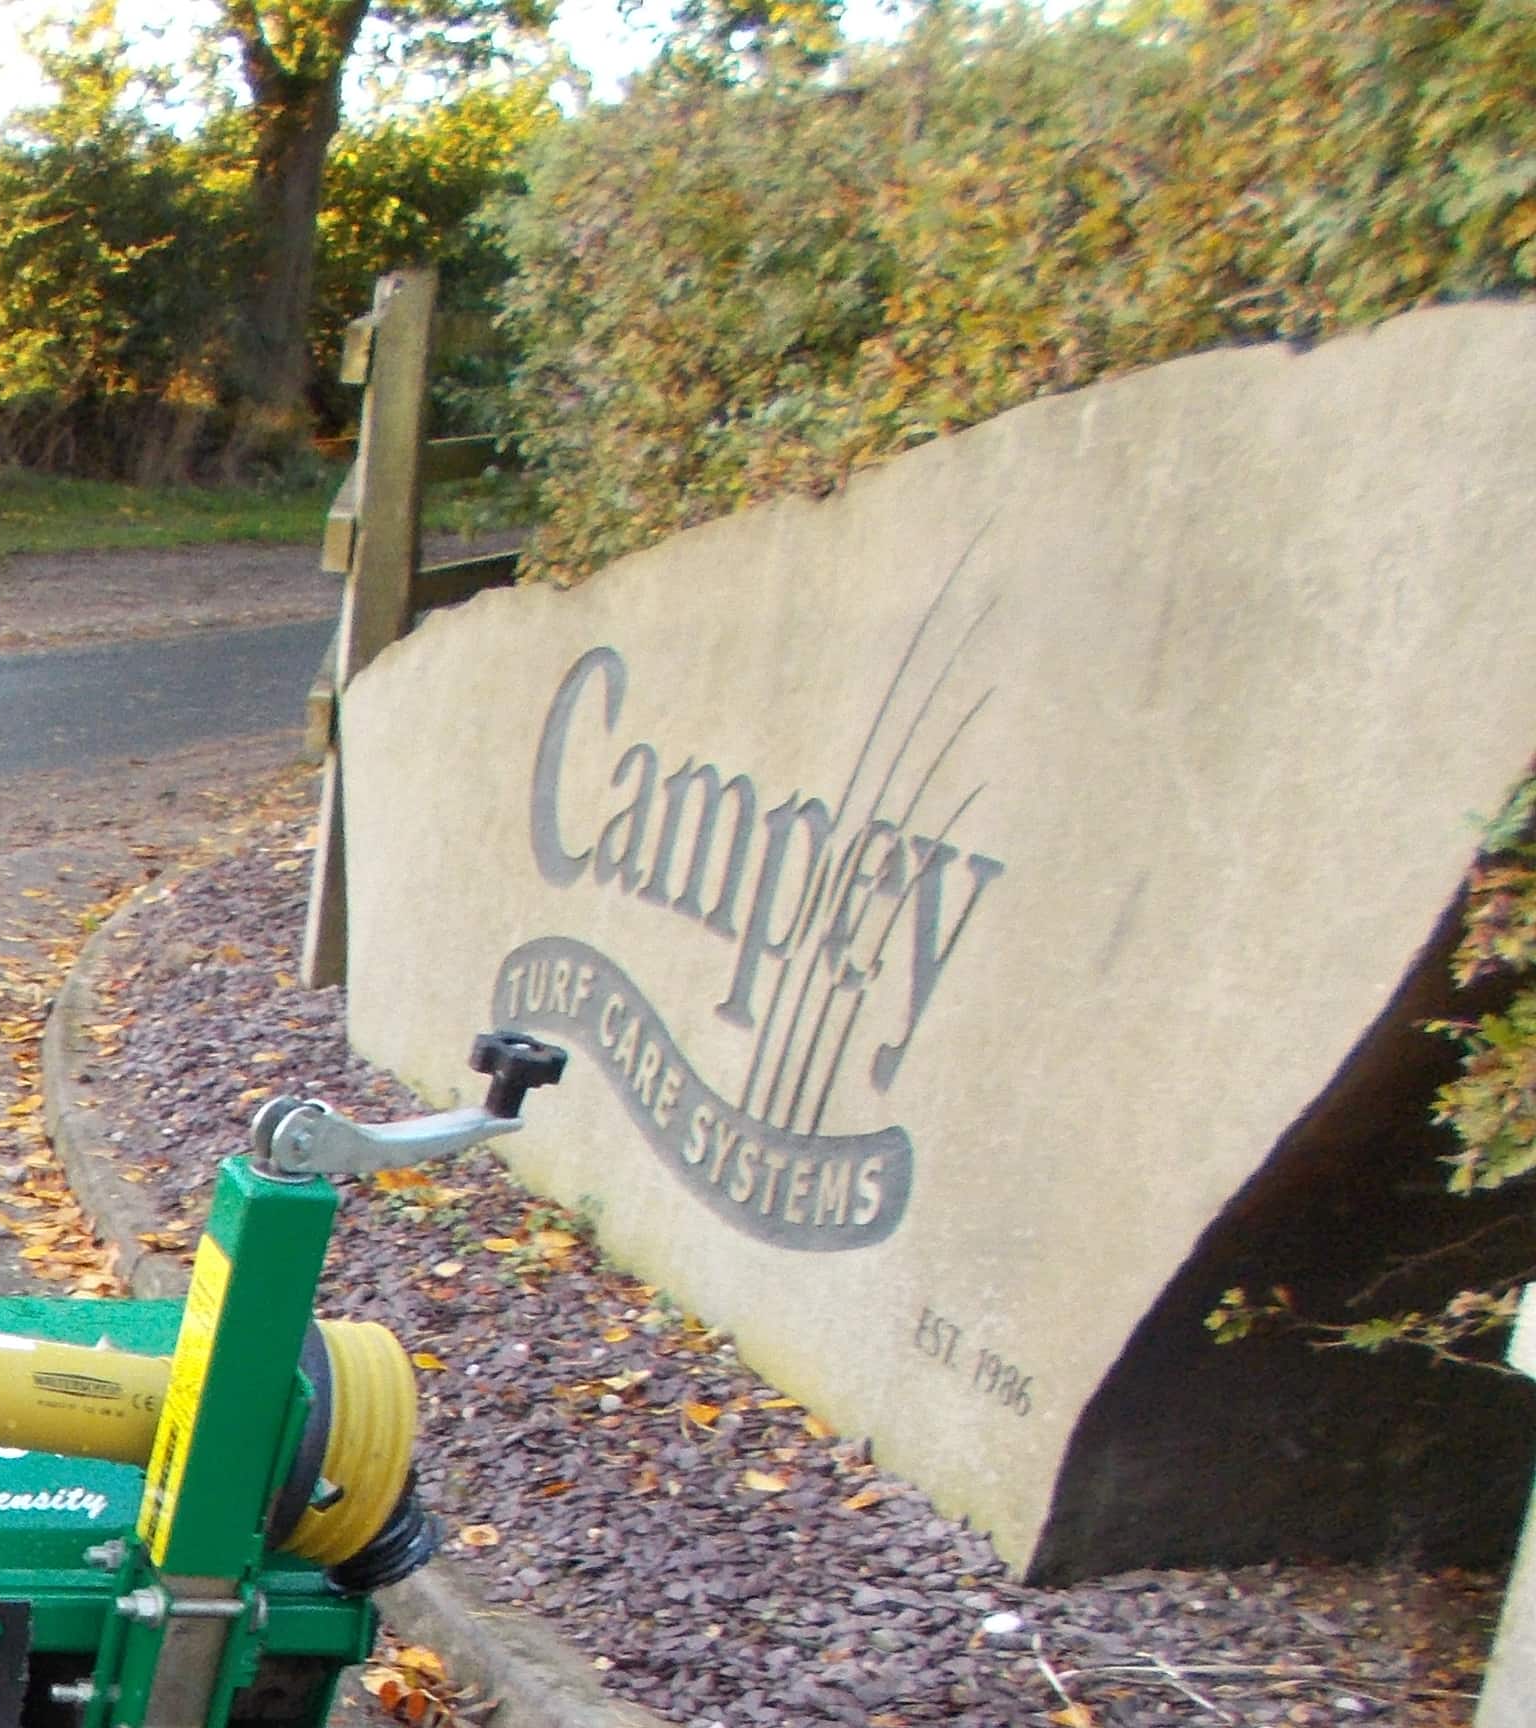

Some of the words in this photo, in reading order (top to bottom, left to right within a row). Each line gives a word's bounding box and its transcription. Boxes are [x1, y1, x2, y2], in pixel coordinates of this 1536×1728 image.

[530, 646, 1005, 1093] Campey
[508, 960, 597, 1019] TURF
[599, 994, 686, 1129] CARE
[681, 1104, 886, 1227] SYSTEMS
